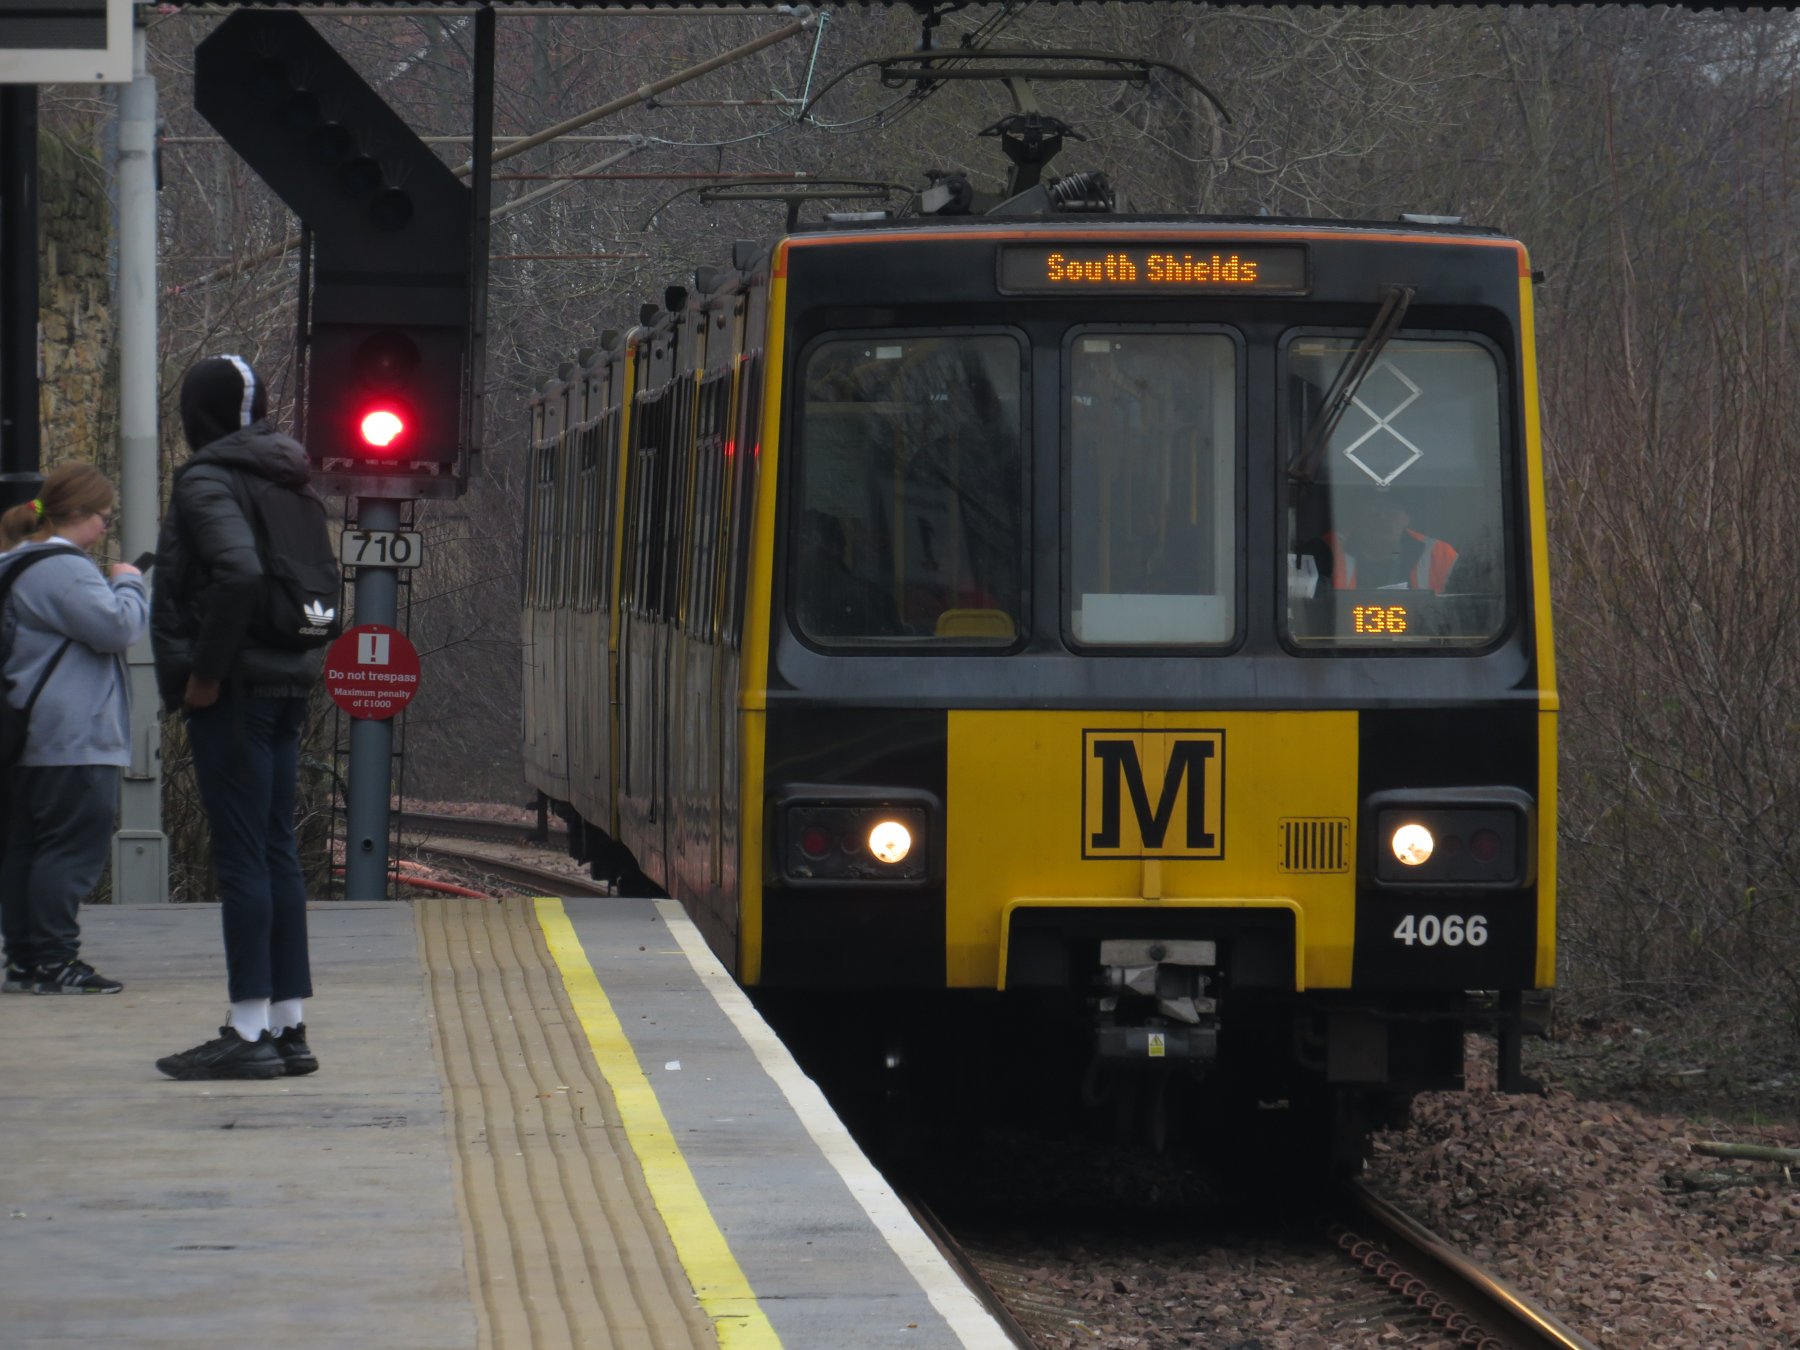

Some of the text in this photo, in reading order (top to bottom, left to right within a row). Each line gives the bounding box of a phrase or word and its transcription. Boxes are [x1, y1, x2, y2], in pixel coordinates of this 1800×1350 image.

[1047, 254, 1257, 282] South Shields
[352, 535, 411, 563] 710
[1353, 606, 1407, 633] 136
[328, 669, 417, 684] Do not trespass
[334, 687, 411, 700] Maximum penalty
[352, 699, 392, 709] of £1000
[1091, 740, 1215, 849] M
[1393, 914, 1488, 947] 4066
